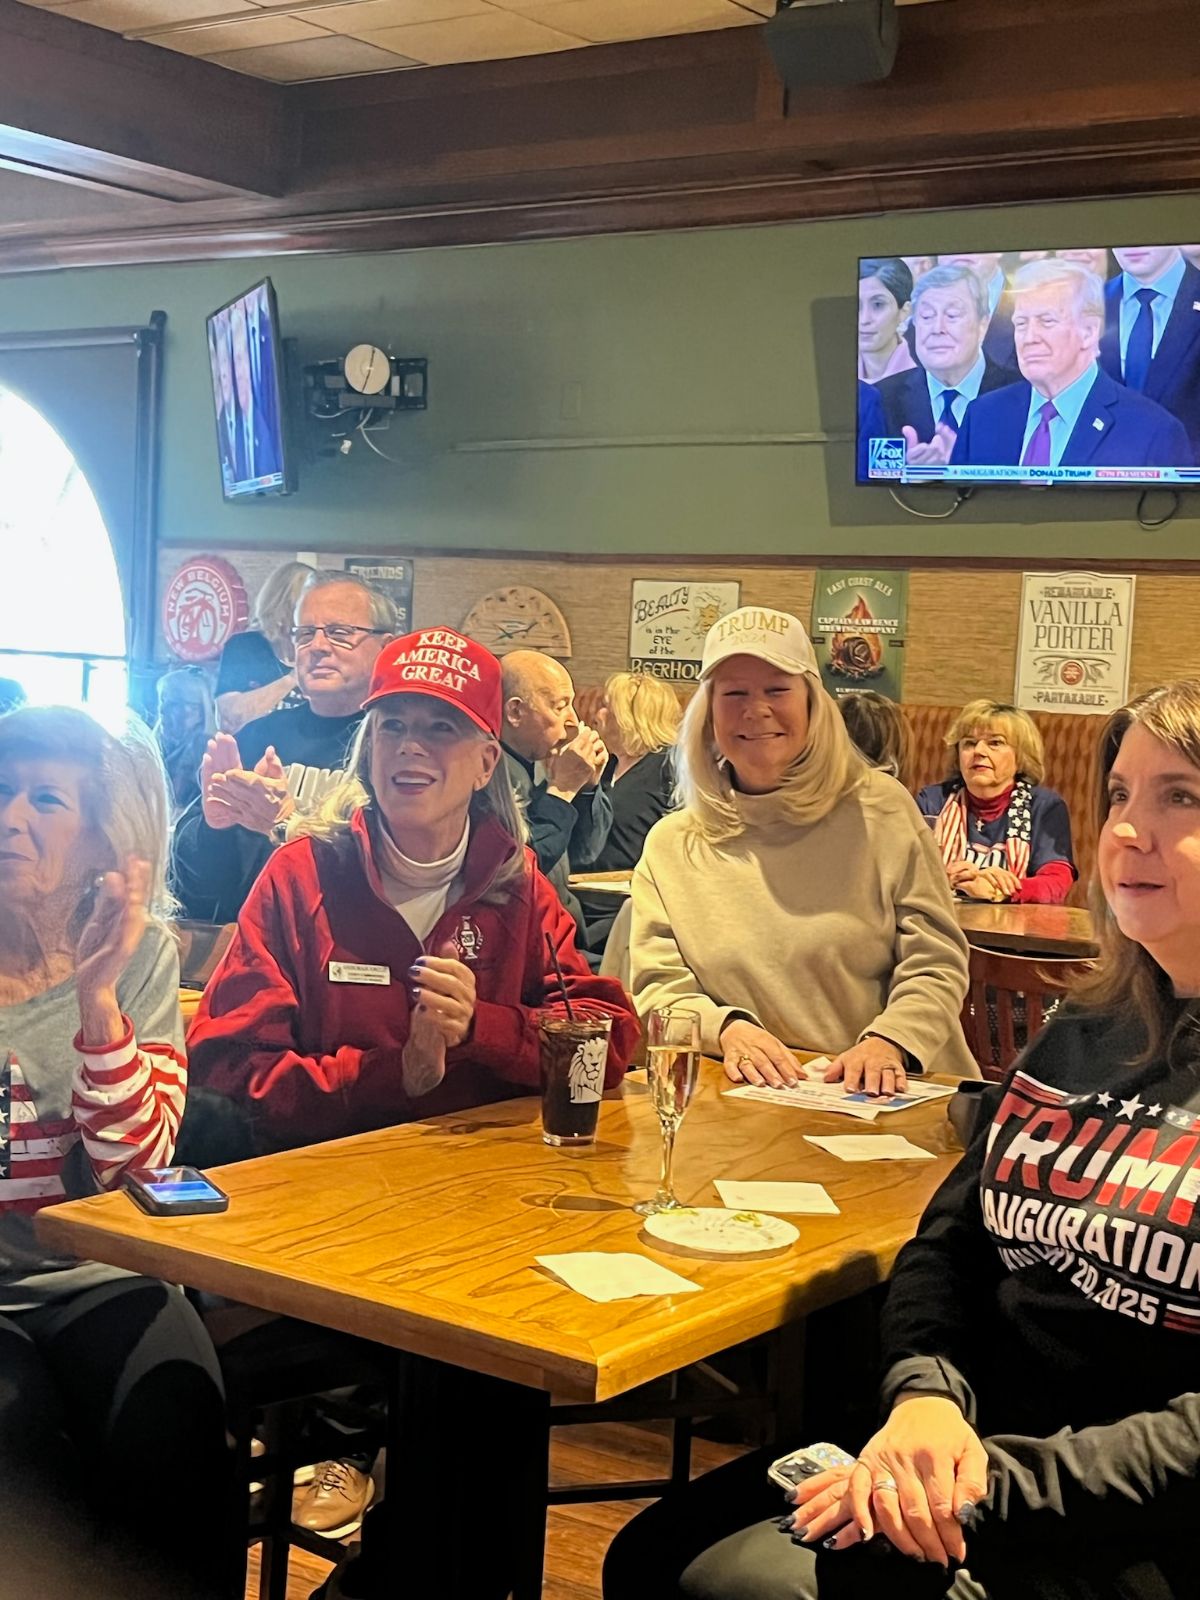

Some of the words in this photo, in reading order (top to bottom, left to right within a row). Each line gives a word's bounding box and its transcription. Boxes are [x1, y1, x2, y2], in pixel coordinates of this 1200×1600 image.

[876, 459, 903, 469] NEWS
[881, 448, 902, 458] FOX
[1029, 469, 1063, 477] DONALD
[1065, 470, 1091, 478] TRUMP
[168, 579, 184, 612] NEW
[187, 570, 229, 616] BELGIUM
[1029, 600, 1123, 626] VANILLA
[719, 611, 789, 641] TRUMP
[1034, 625, 1113, 651] PORTER
[416, 630, 468, 653] KEEP
[653, 635, 672, 645] EYE
[392, 648, 481, 681] AMERICA
[631, 659, 702, 679] BEERHO
[401, 665, 467, 692] GREAT
